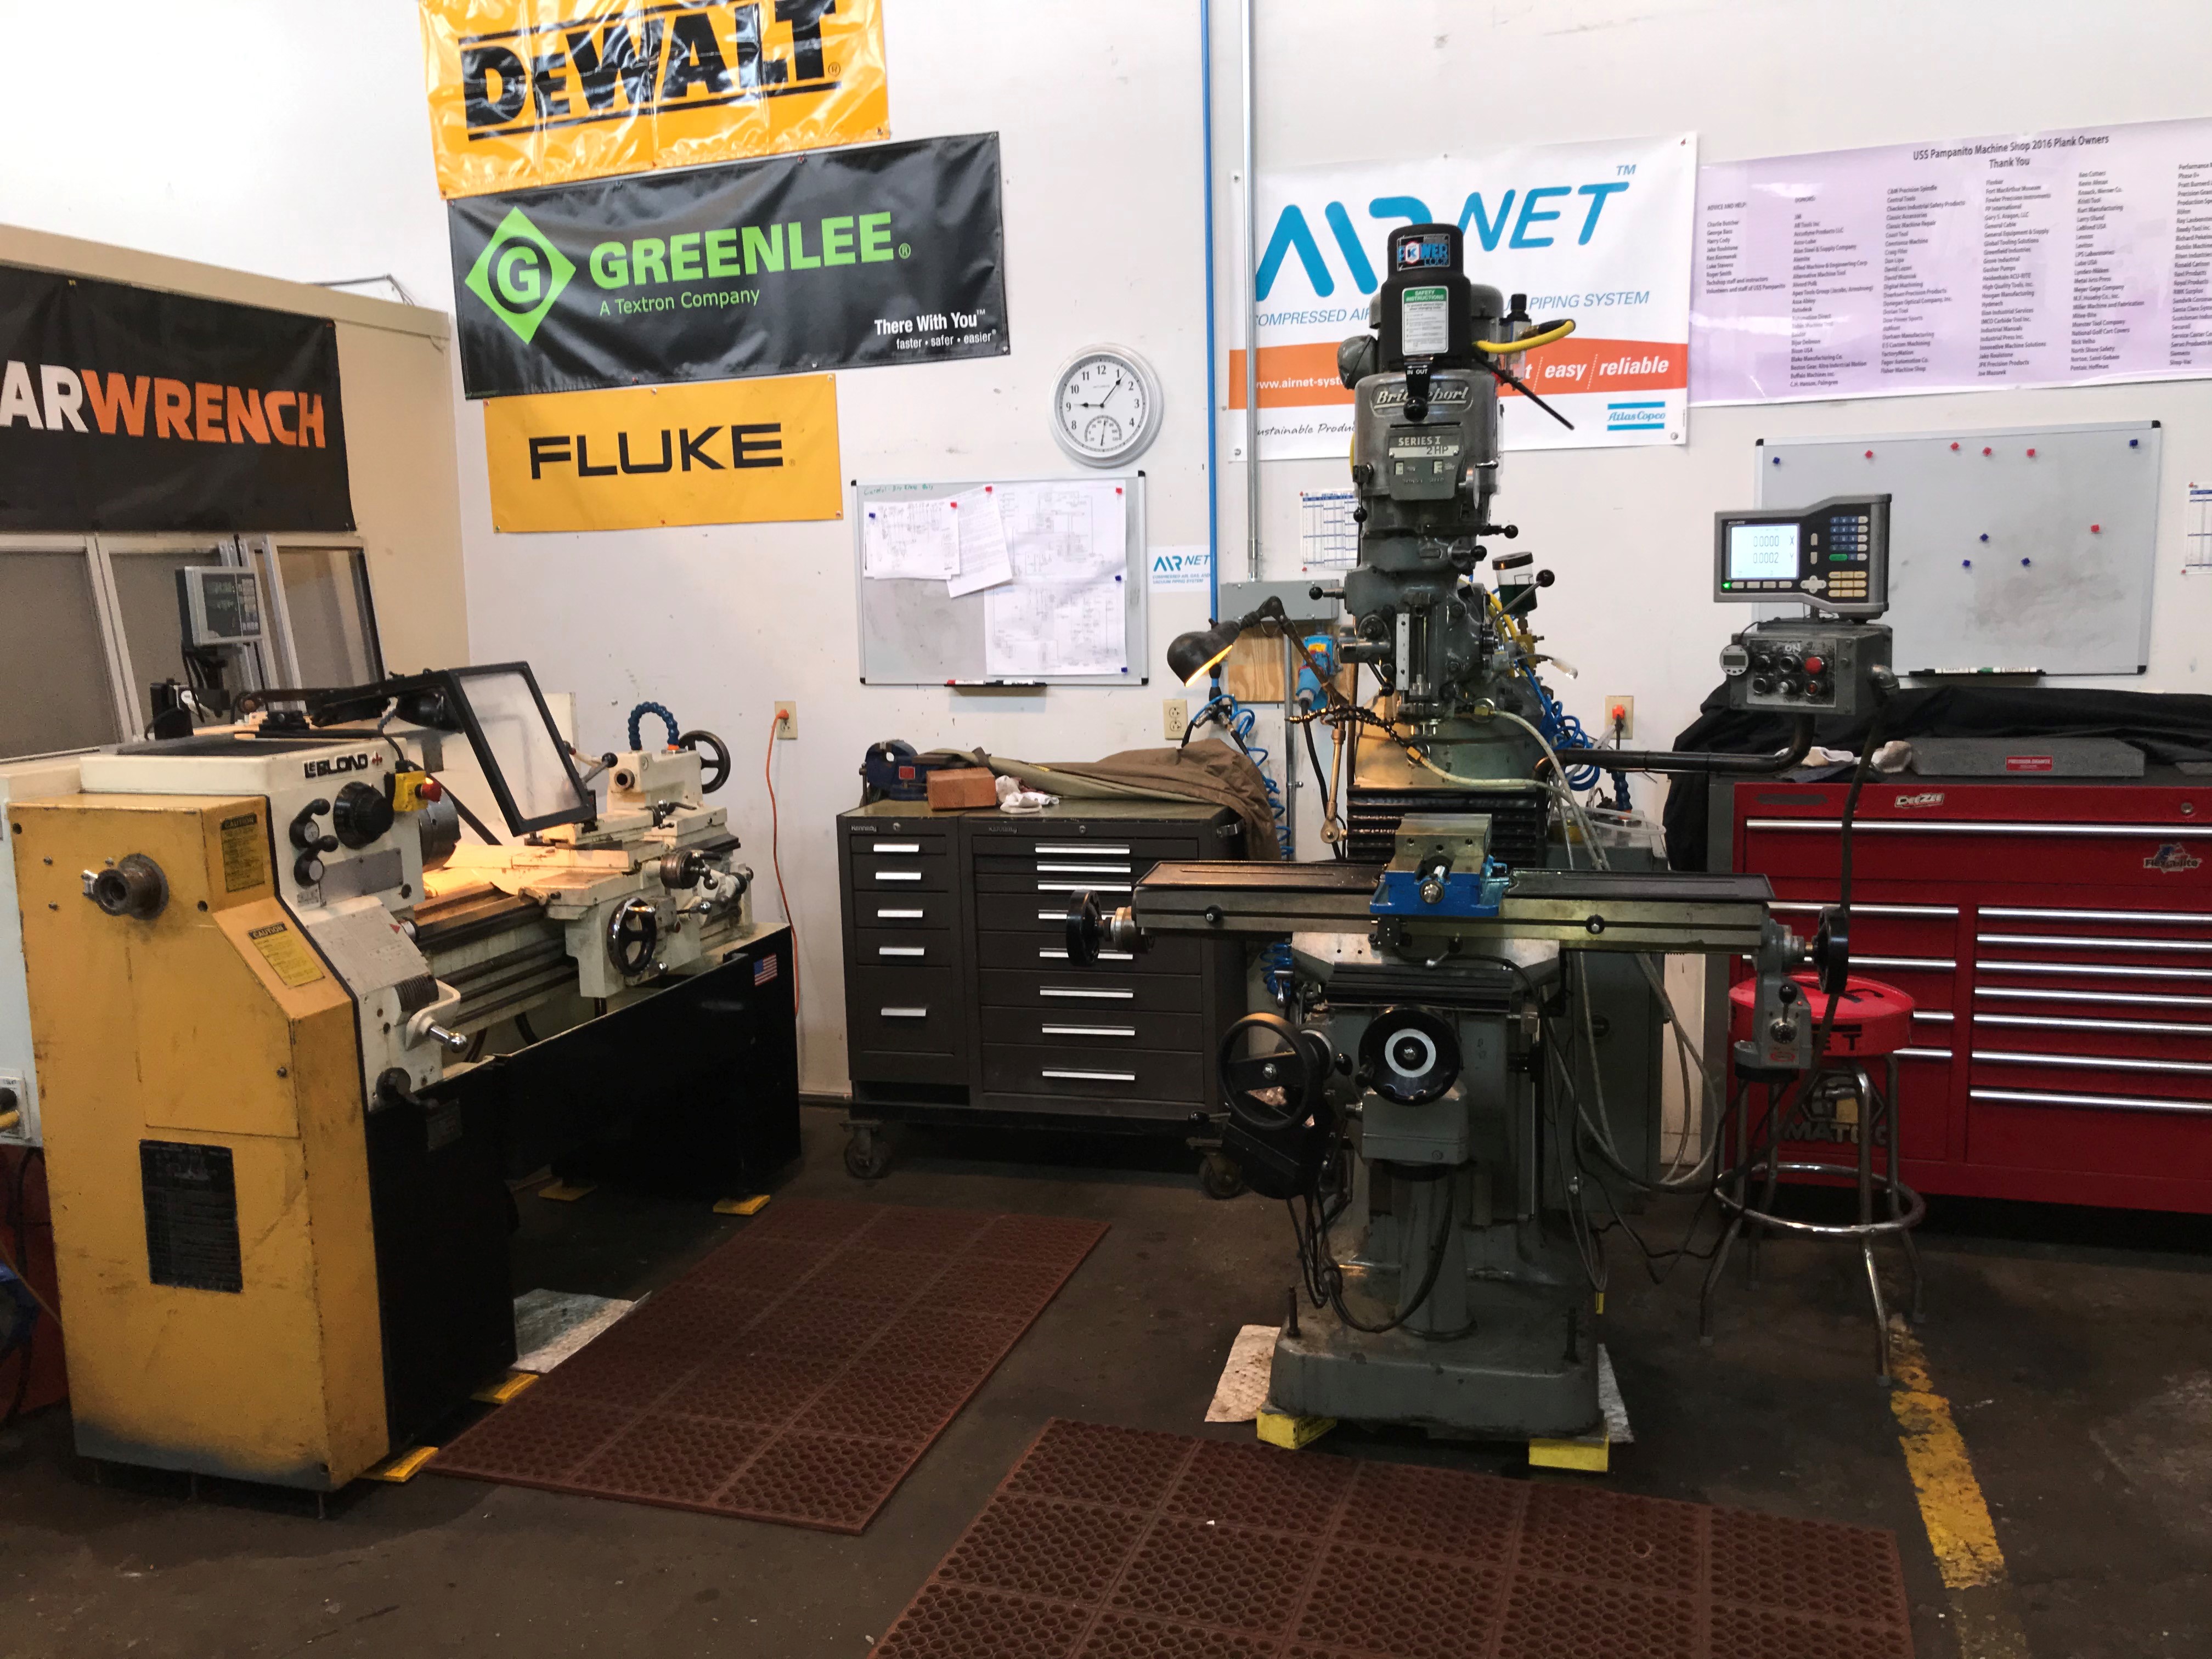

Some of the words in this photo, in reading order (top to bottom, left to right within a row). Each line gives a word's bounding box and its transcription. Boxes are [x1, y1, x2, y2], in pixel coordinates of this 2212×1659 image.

[1913, 150, 1928, 160] USS
[1930, 148, 1973, 159] Pampanito
[1975, 144, 2008, 155] Machine
[2010, 142, 2030, 153] Shop
[2032, 139, 2052, 150] 2016
[2054, 137, 2076, 148] Plank
[2078, 135, 2109, 145] Owners
[1989, 159, 2013, 169] Thank
[2016, 157, 2030, 166] You
[589, 211, 894, 290] GREENLEE
[600, 300, 610, 316] A
[615, 295, 674, 314] Textron
[681, 289, 760, 309] Company
[1529, 294, 1580, 309] PIPING
[1583, 291, 1650, 307] SYSTEM
[1256, 308, 1346, 326] OMPRESSED
[874, 319, 913, 335] There
[916, 313, 947, 332] With
[896, 338, 922, 350] faster
[931, 334, 953, 347] safer
[964, 331, 991, 345] easier
[1097, 365, 1106, 375] 12
[1116, 369, 1120, 377] 1
[1545, 363, 1587, 381] easy
[1599, 356, 1669, 376] reliable
[1082, 371, 1089, 380] 11
[1128, 381, 1133, 391] 2
[1256, 376, 1343, 389] ww.airnet-syst
[1070, 385, 1079, 393] 10
[1066, 402, 1071, 411] 9
[1135, 399, 1139, 408] 3
[1607, 411, 1636, 421] Atlas
[1637, 411, 1666, 421] Copco
[1071, 420, 1076, 430] 8
[1129, 417, 1135, 427] 4
[1256, 424, 1313, 436] ustainable
[1399, 437, 1432, 446] SERIES
[529, 423, 783, 479] FLUKE
[1790, 535, 1795, 546] X
[1790, 552, 1794, 562] Y
[1785, 644, 1801, 652] ON
